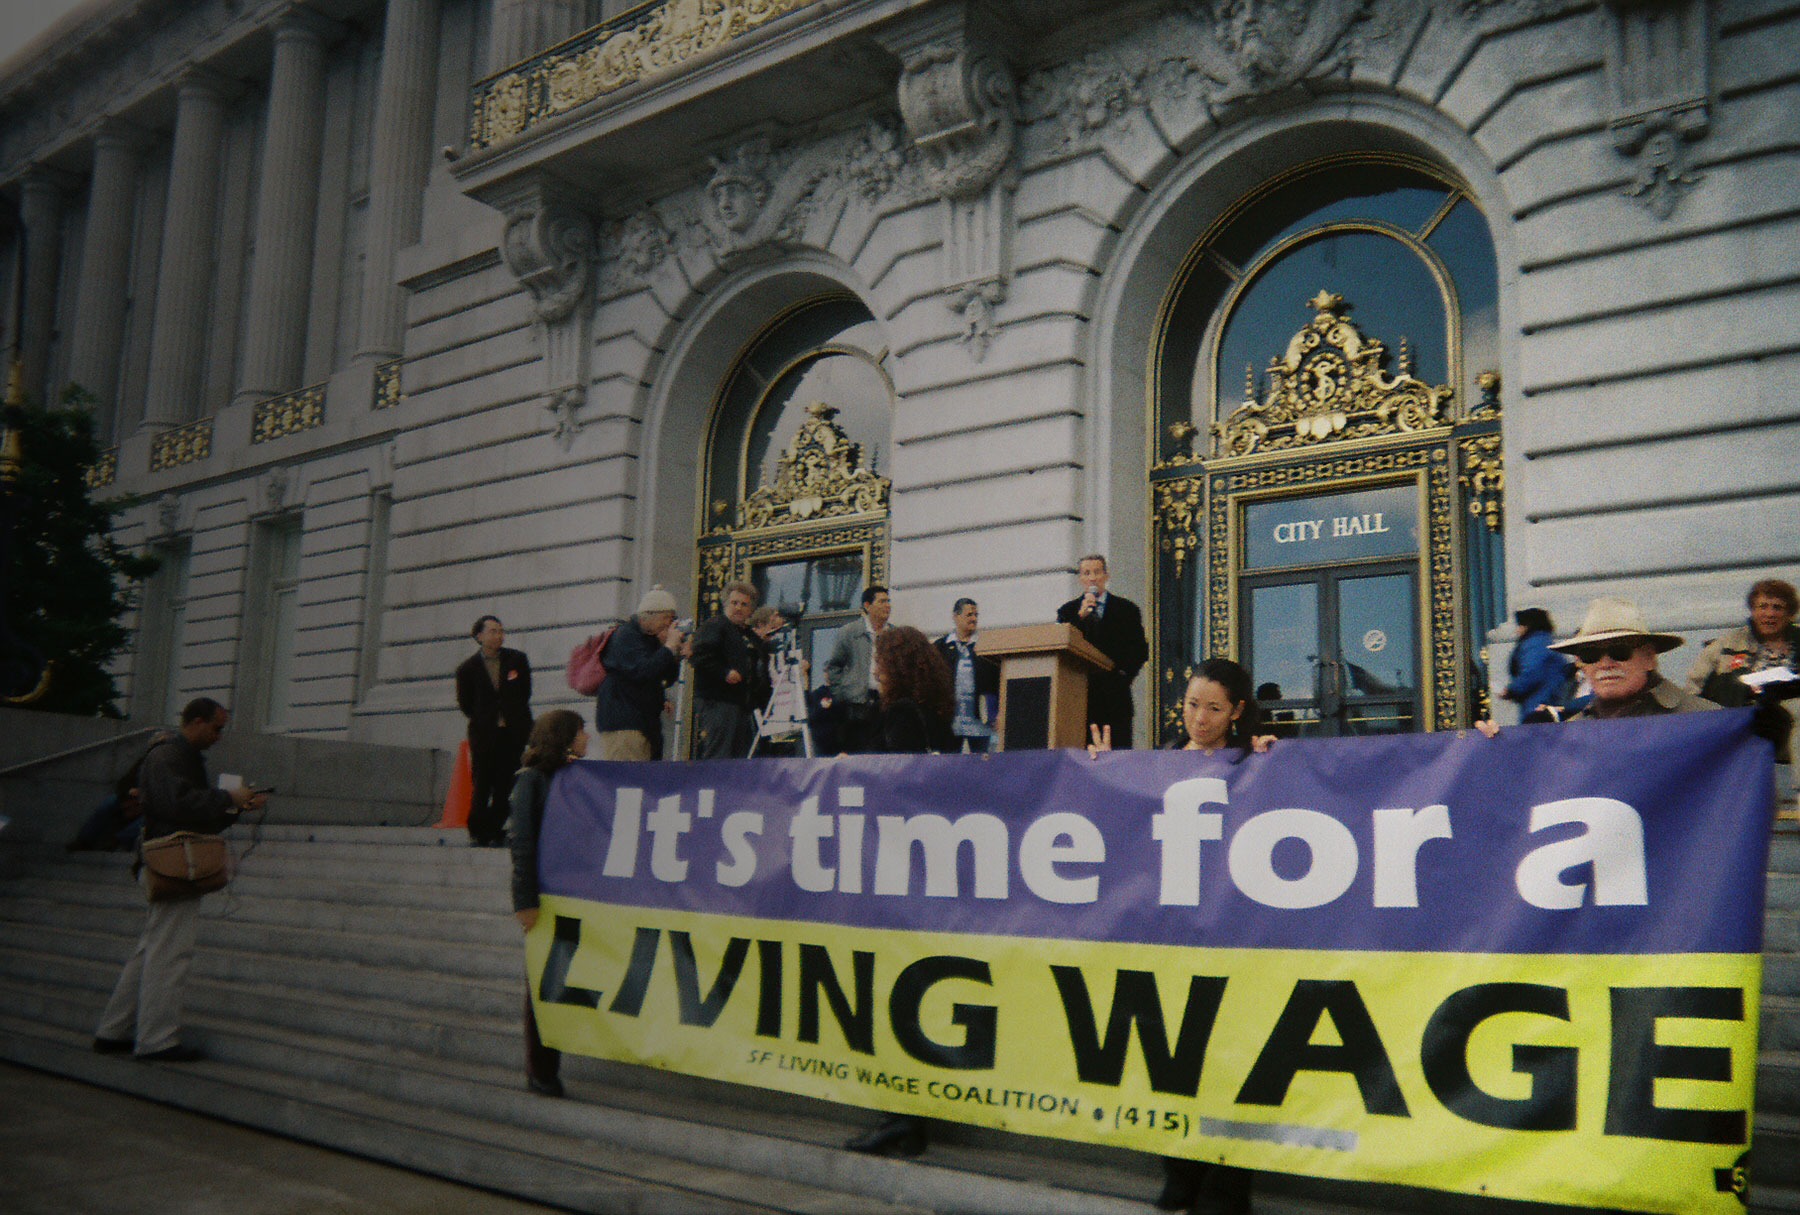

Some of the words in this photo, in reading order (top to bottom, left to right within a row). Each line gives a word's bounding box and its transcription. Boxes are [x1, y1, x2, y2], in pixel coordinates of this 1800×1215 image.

[1273, 519, 1324, 543] CITY
[1332, 512, 1390, 537] HALL
[602, 787, 764, 887] It's
[789, 786, 1106, 904] time
[1151, 777, 1453, 910] for
[1515, 796, 1649, 910] a
[539, 915, 998, 1071] LIVING
[1049, 964, 1748, 1146] WAGE
[746, 1050, 774, 1064] SF
[777, 1053, 849, 1080] LIVING
[855, 1066, 920, 1095] WAGE
[927, 1080, 1080, 1117] COALITION
[1114, 1105, 1191, 1139] (415)
